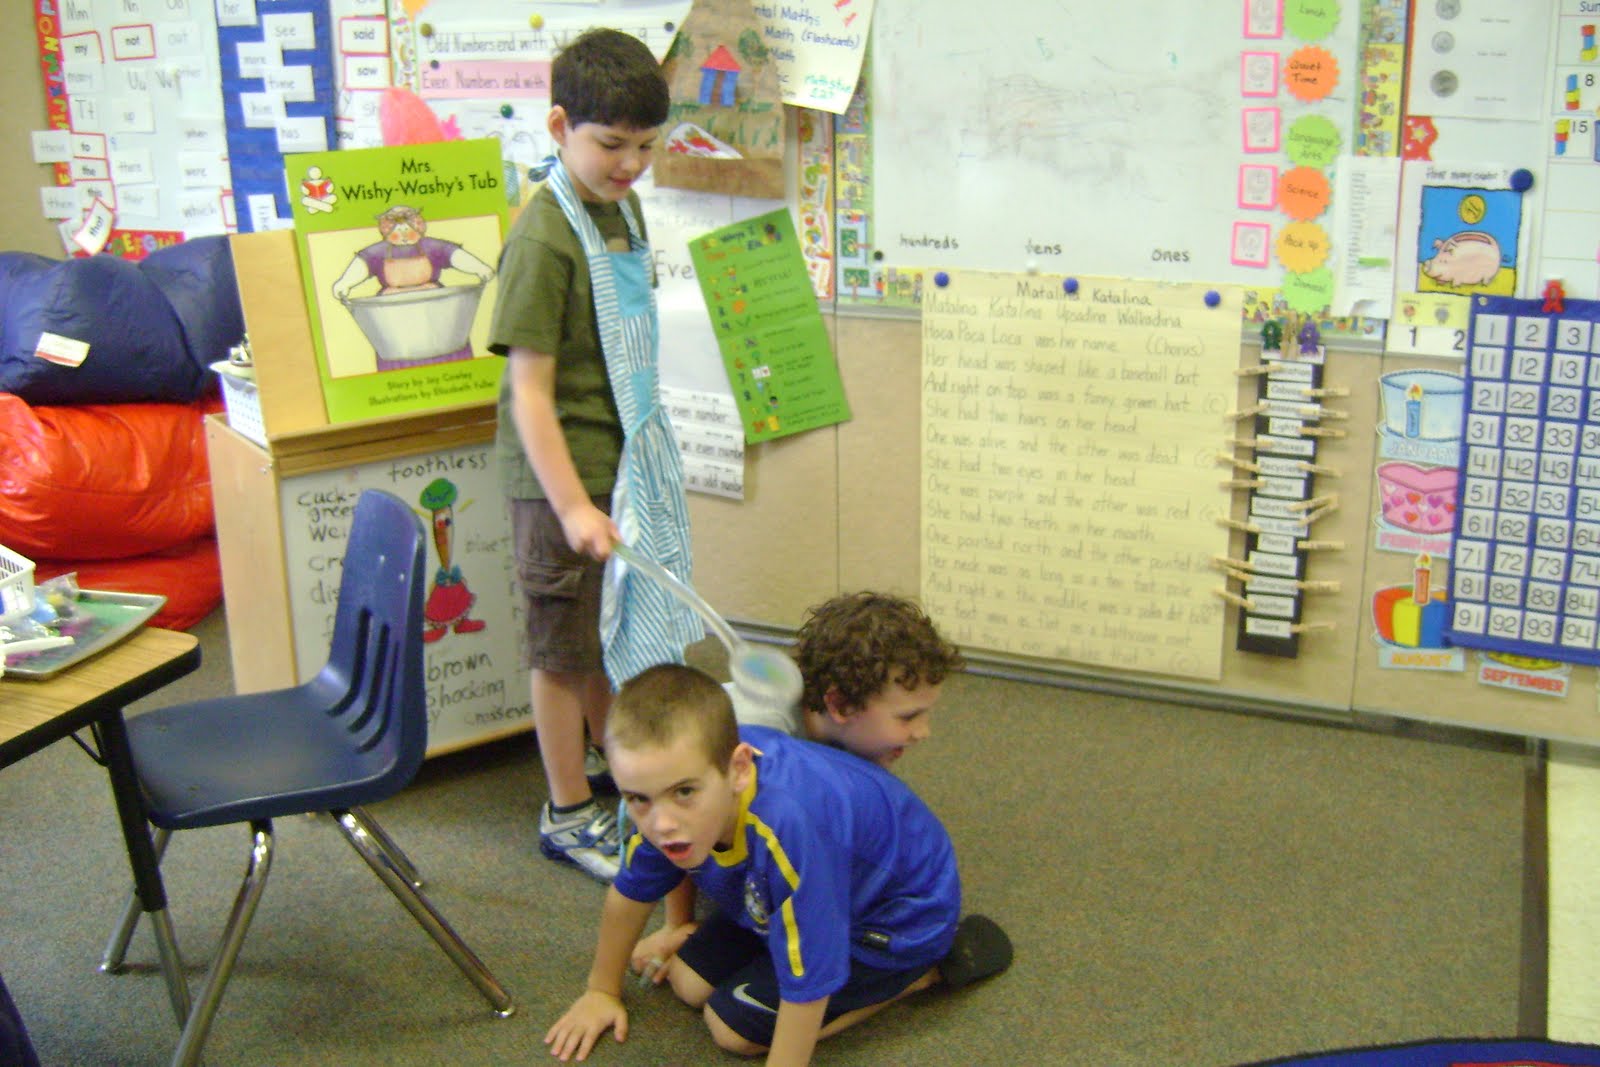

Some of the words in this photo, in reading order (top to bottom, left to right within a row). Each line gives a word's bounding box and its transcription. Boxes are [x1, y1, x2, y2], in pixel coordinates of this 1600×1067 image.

[125, 36, 140, 46] not
[353, 28, 375, 40] said
[357, 67, 377, 76] saw
[422, 71, 449, 89] Even
[1585, 74, 1595, 87] 8
[1572, 120, 1588, 133] 15
[81, 142, 91, 152] to
[341, 176, 464, 203] Wishy-Washy's
[469, 170, 498, 190] Tub
[1287, 184, 1319, 199] Science
[900, 234, 959, 250] hundreds
[1025, 239, 1062, 255] tens
[1092, 288, 1152, 306] Katalina
[1409, 326, 1417, 347] 1
[1453, 330, 1466, 351] 2
[1489, 322, 1495, 340] 1
[1525, 324, 1539, 342] 2
[1567, 327, 1581, 346] 3
[1480, 353, 1494, 371] 11
[1519, 357, 1538, 375] 12
[1559, 360, 1578, 379] 13
[1478, 389, 1499, 407] 21
[1510, 391, 1536, 410] 22
[1551, 394, 1577, 414] 23
[1471, 421, 1494, 440] 31
[1508, 424, 1534, 444] 32
[1545, 428, 1573, 447] 33
[388, 454, 487, 482] toothless
[1474, 453, 1496, 471] 41
[1506, 456, 1534, 476] 42
[1543, 459, 1569, 480] 43
[1470, 485, 1492, 504] 51
[1504, 488, 1530, 508] 52
[1539, 491, 1566, 511] 53
[309, 506, 355, 523] gree
[1468, 515, 1489, 533] 61
[1500, 518, 1526, 539] 62
[1539, 524, 1566, 543] 63
[1575, 528, 1600, 547] 64
[1460, 547, 1481, 566] 71
[1498, 551, 1523, 571] 72
[1536, 556, 1562, 577] 73
[1575, 560, 1600, 580] 74
[1460, 577, 1481, 595] 81
[1492, 581, 1518, 602] 82
[1530, 588, 1556, 607] 83
[1567, 592, 1594, 612] 84
[1459, 608, 1479, 626] 91
[1492, 614, 1518, 634] 92
[1526, 619, 1553, 638] 93
[1565, 623, 1591, 642] 94
[427, 651, 492, 682] brown
[1481, 667, 1564, 692] SEPTEMBER
